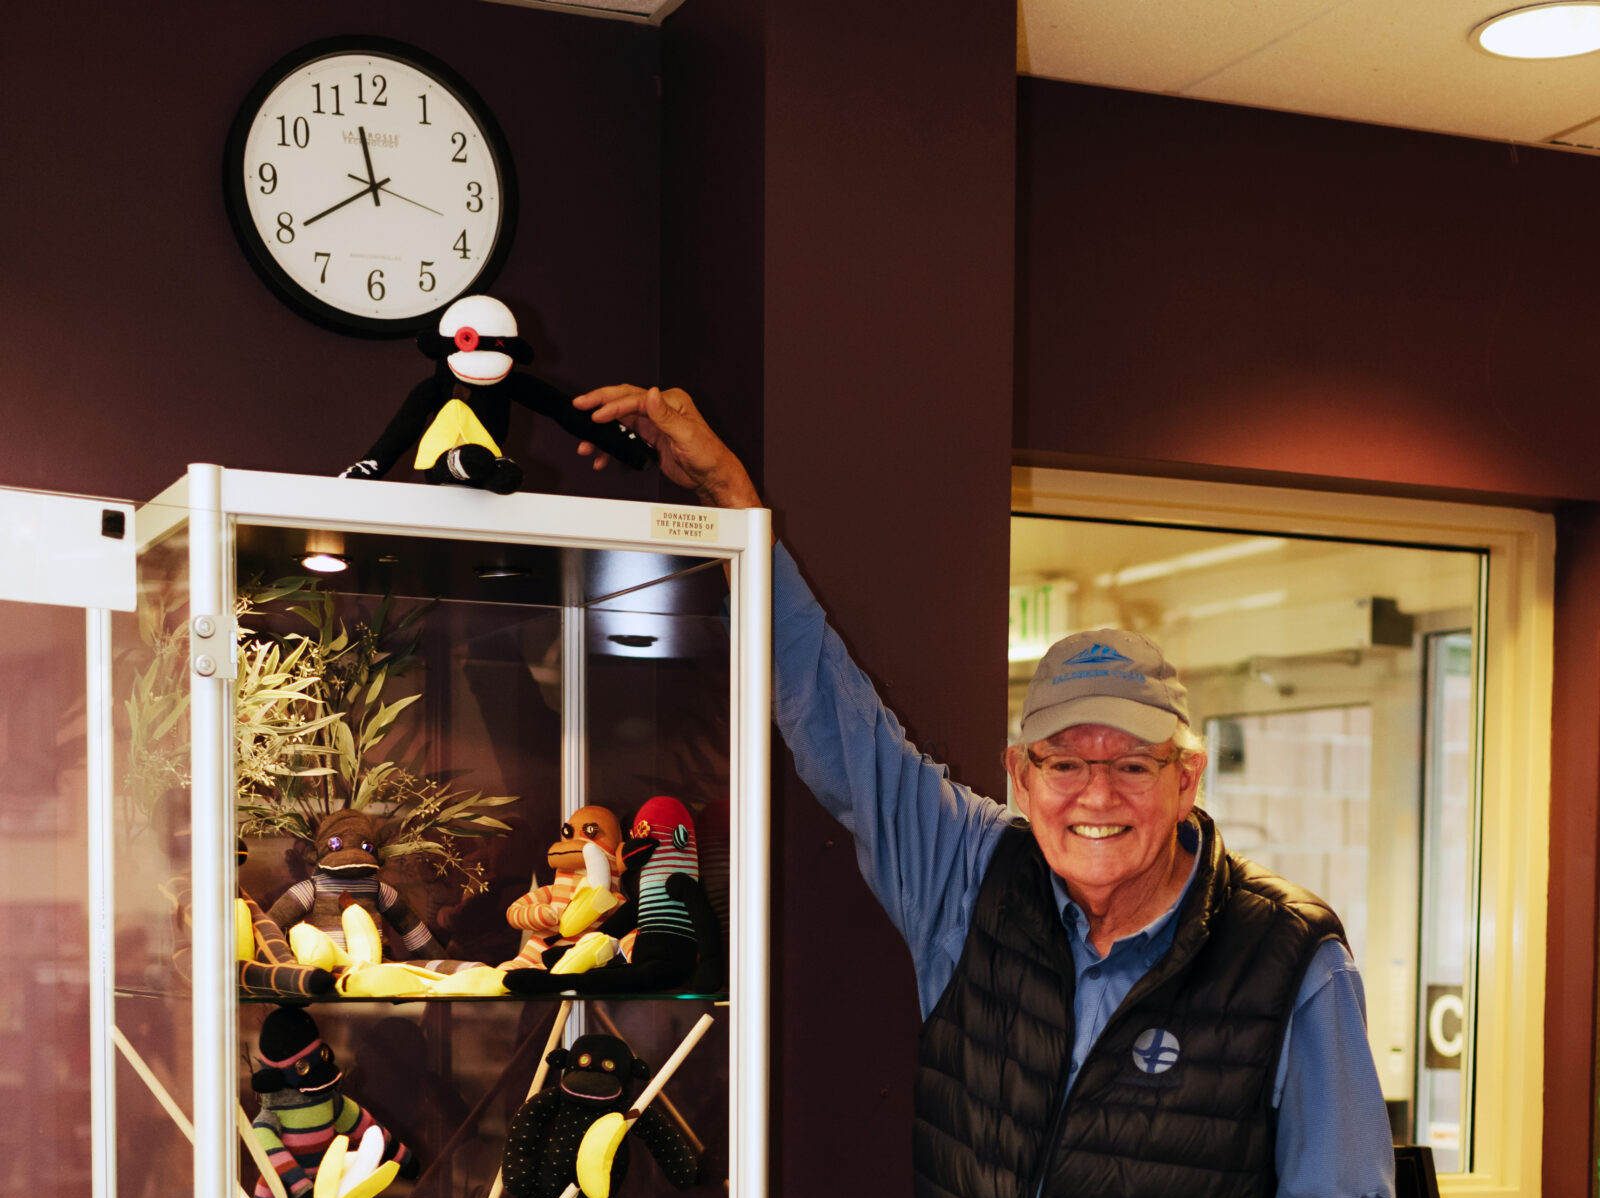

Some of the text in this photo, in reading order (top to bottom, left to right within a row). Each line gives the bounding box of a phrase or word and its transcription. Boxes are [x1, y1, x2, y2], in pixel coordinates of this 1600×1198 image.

[312, 83, 344, 116] 11
[354, 73, 387, 106] 12
[418, 94, 431, 125] 1
[276, 115, 309, 148] 10
[451, 132, 467, 163] 2
[259, 163, 277, 194] 9
[466, 182, 483, 212] 3
[276, 212, 295, 244] 8
[453, 229, 471, 259] 4
[315, 252, 331, 283] 7
[419, 261, 436, 292] 5
[368, 270, 385, 301] 6
[656, 519, 670, 527] THE
[672, 521, 703, 529] FRIENDS
[663, 512, 695, 521] DONATED
